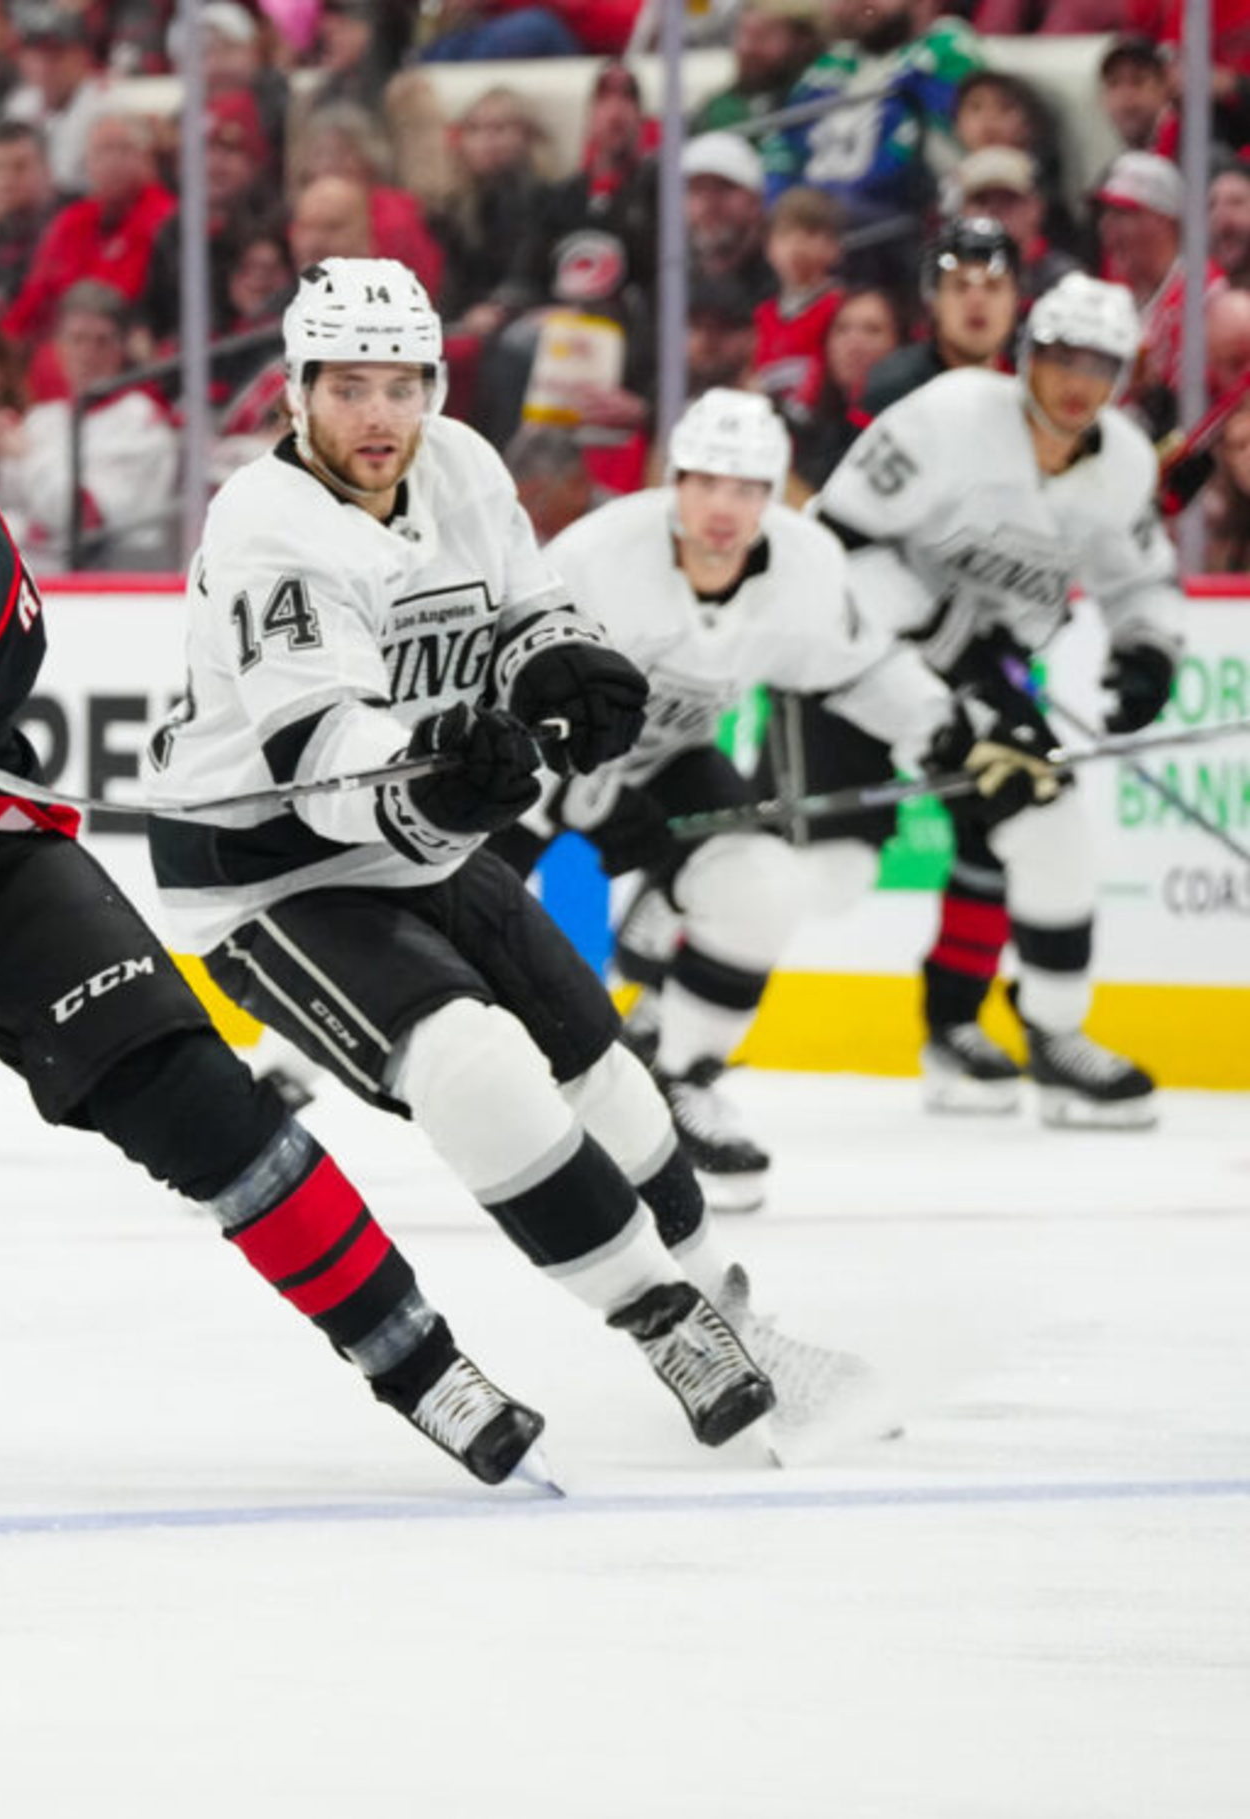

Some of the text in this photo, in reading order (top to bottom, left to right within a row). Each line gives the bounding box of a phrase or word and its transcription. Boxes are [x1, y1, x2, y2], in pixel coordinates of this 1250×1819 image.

[364, 285, 391, 304] 14
[230, 574, 323, 676] 14
[394, 604, 476, 631] Los Angeles
[382, 620, 498, 707] ING
[1155, 656, 1249, 724] OR
[12, 695, 187, 834] PE
[1117, 760, 1250, 829] BAN
[1163, 868, 1250, 914] COA
[50, 955, 155, 1024] CCM
[309, 998, 359, 1049] CCM
